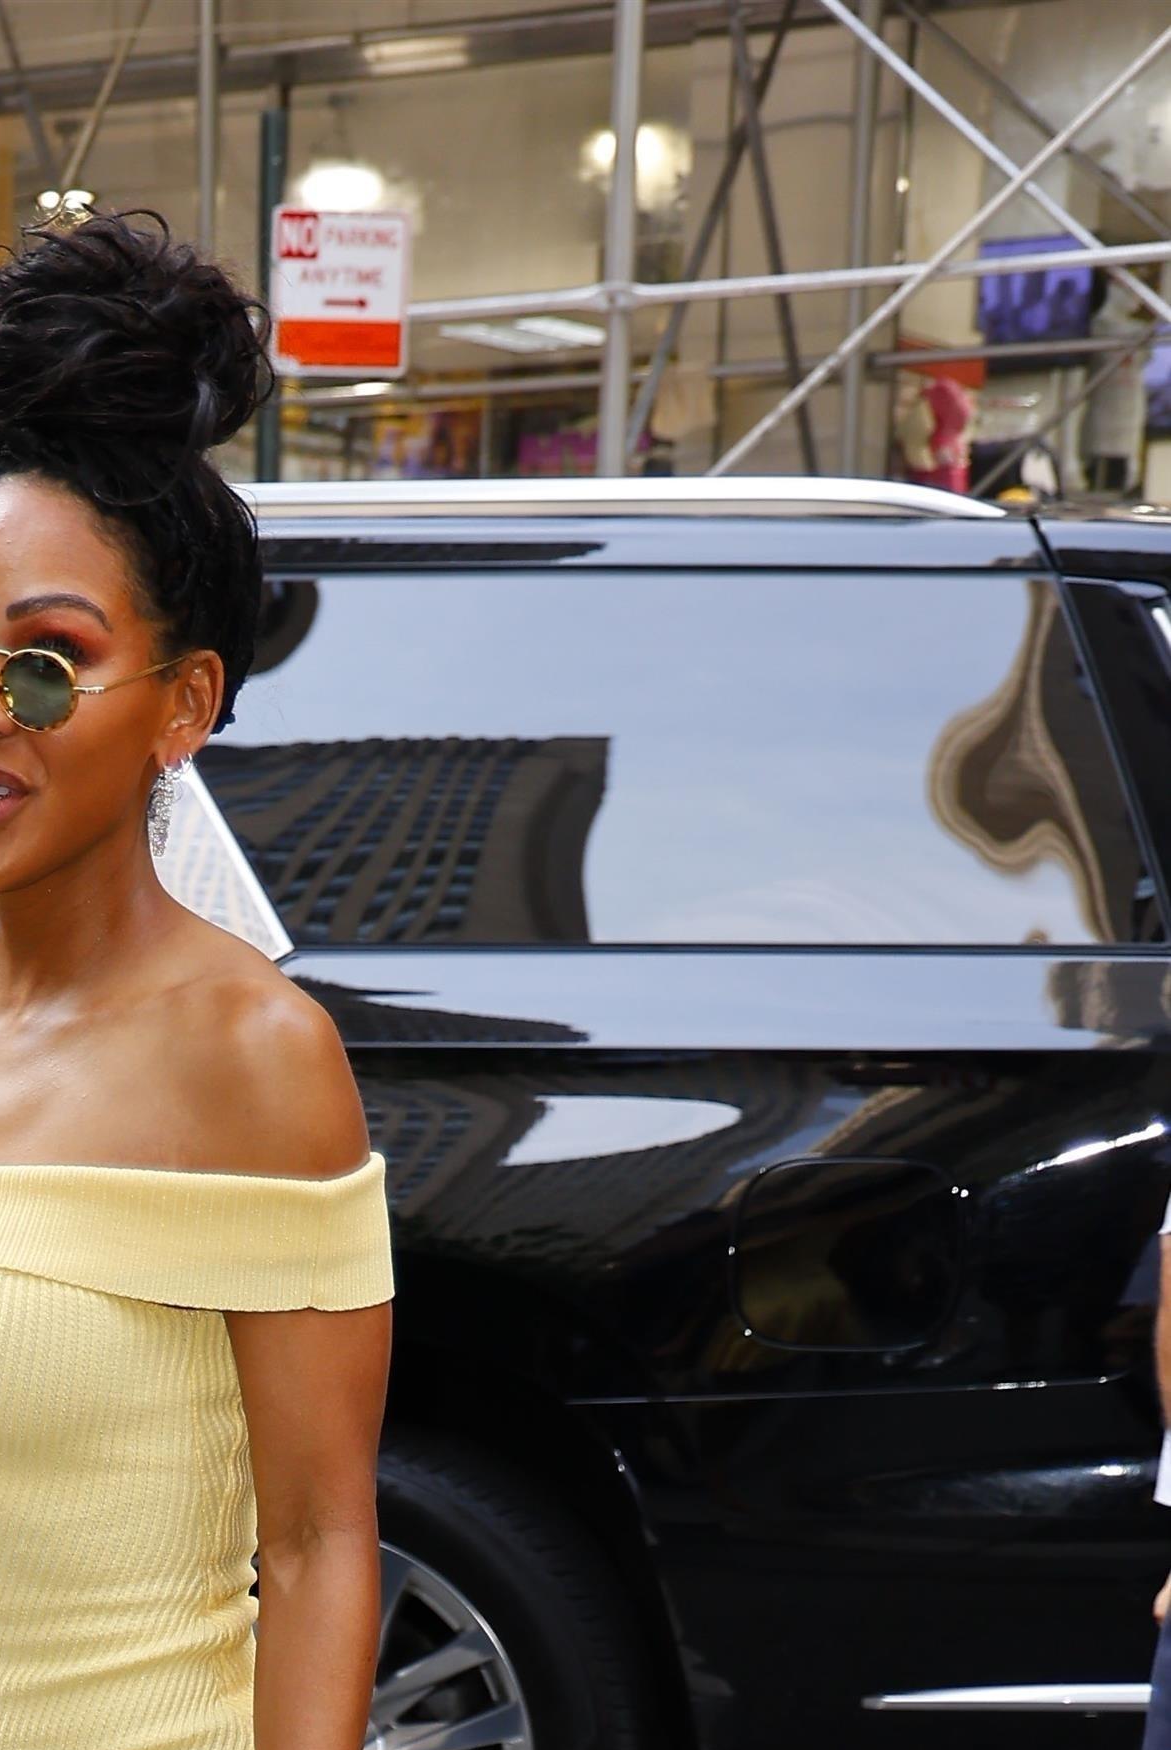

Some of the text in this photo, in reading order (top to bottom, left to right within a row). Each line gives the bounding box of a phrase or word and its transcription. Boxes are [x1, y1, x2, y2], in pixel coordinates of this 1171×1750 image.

[281, 218, 397, 255] NO PARKING
[300, 268, 382, 287] ANYTIME
